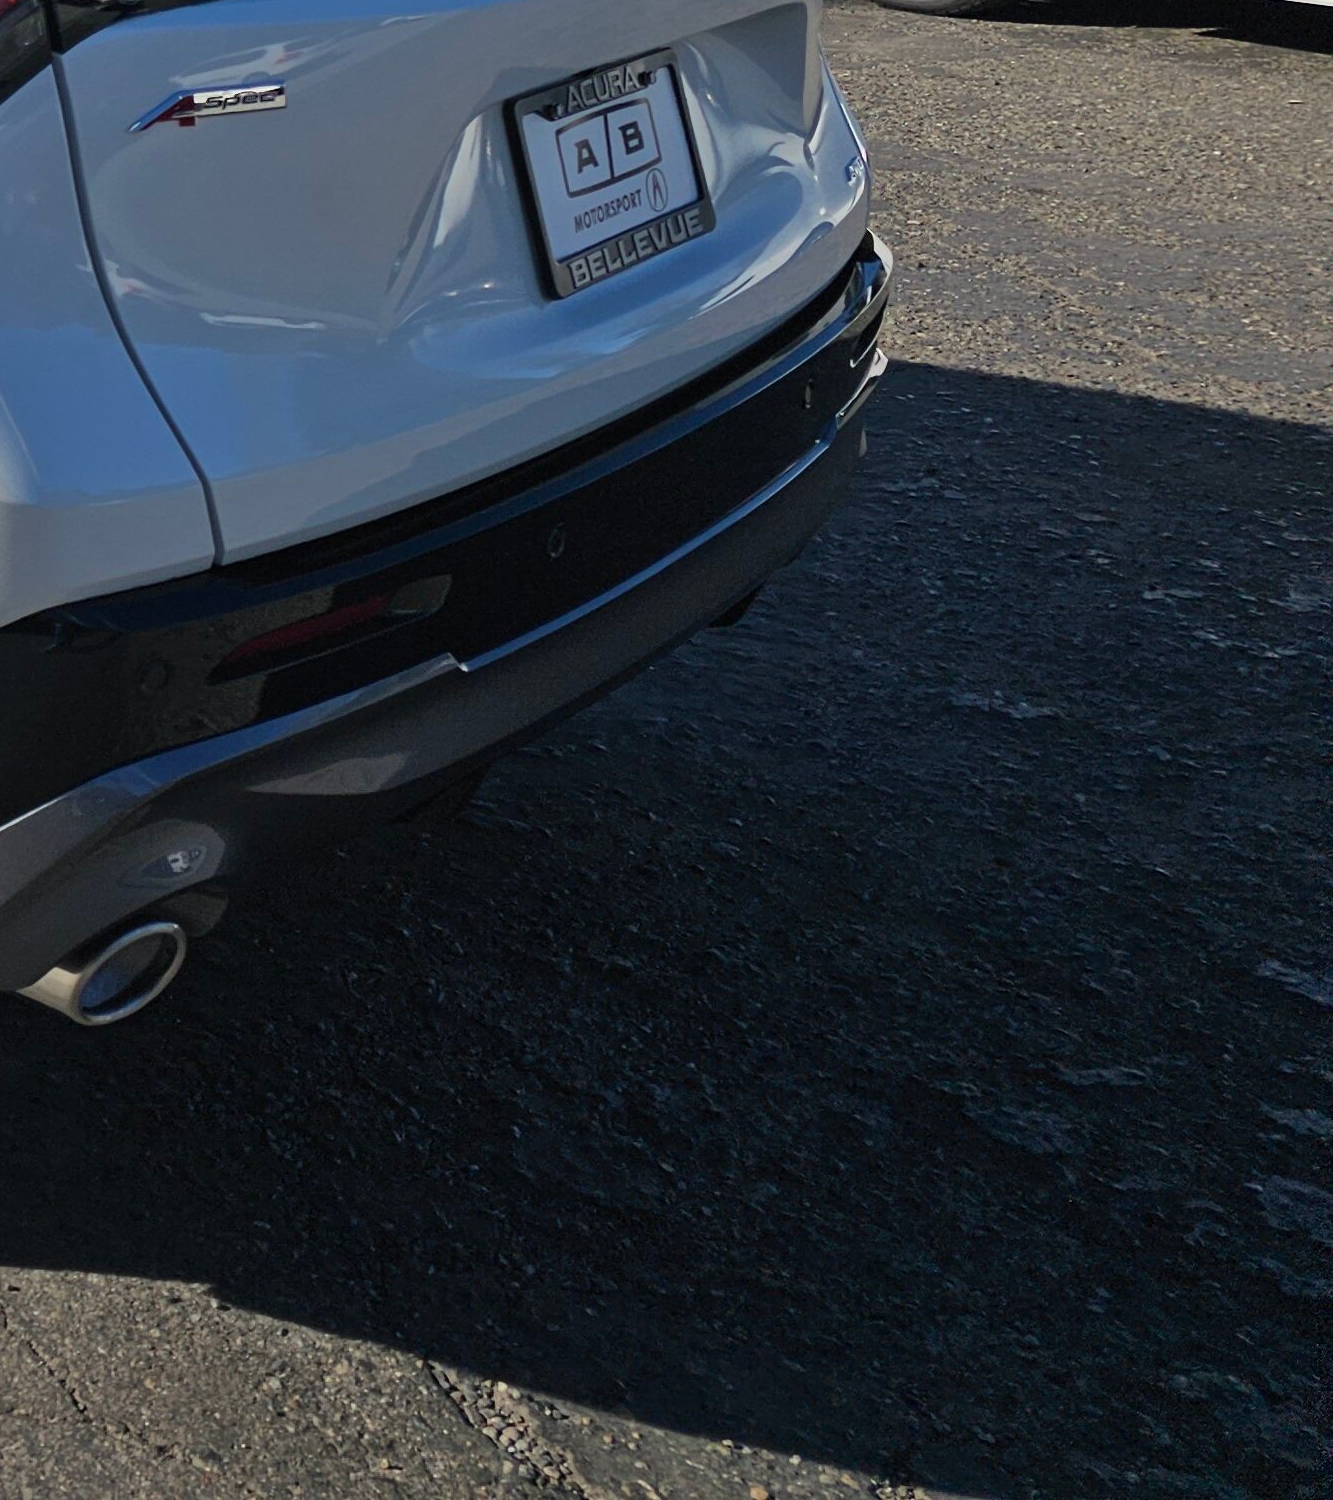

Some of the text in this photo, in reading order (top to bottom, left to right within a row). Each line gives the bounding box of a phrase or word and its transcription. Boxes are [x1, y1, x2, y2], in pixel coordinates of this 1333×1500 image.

[565, 65, 639, 115] ACURA
[574, 120, 645, 174] A B
[574, 188, 643, 234] MOTORSPORT
[566, 208, 704, 289] BELLEVUE
